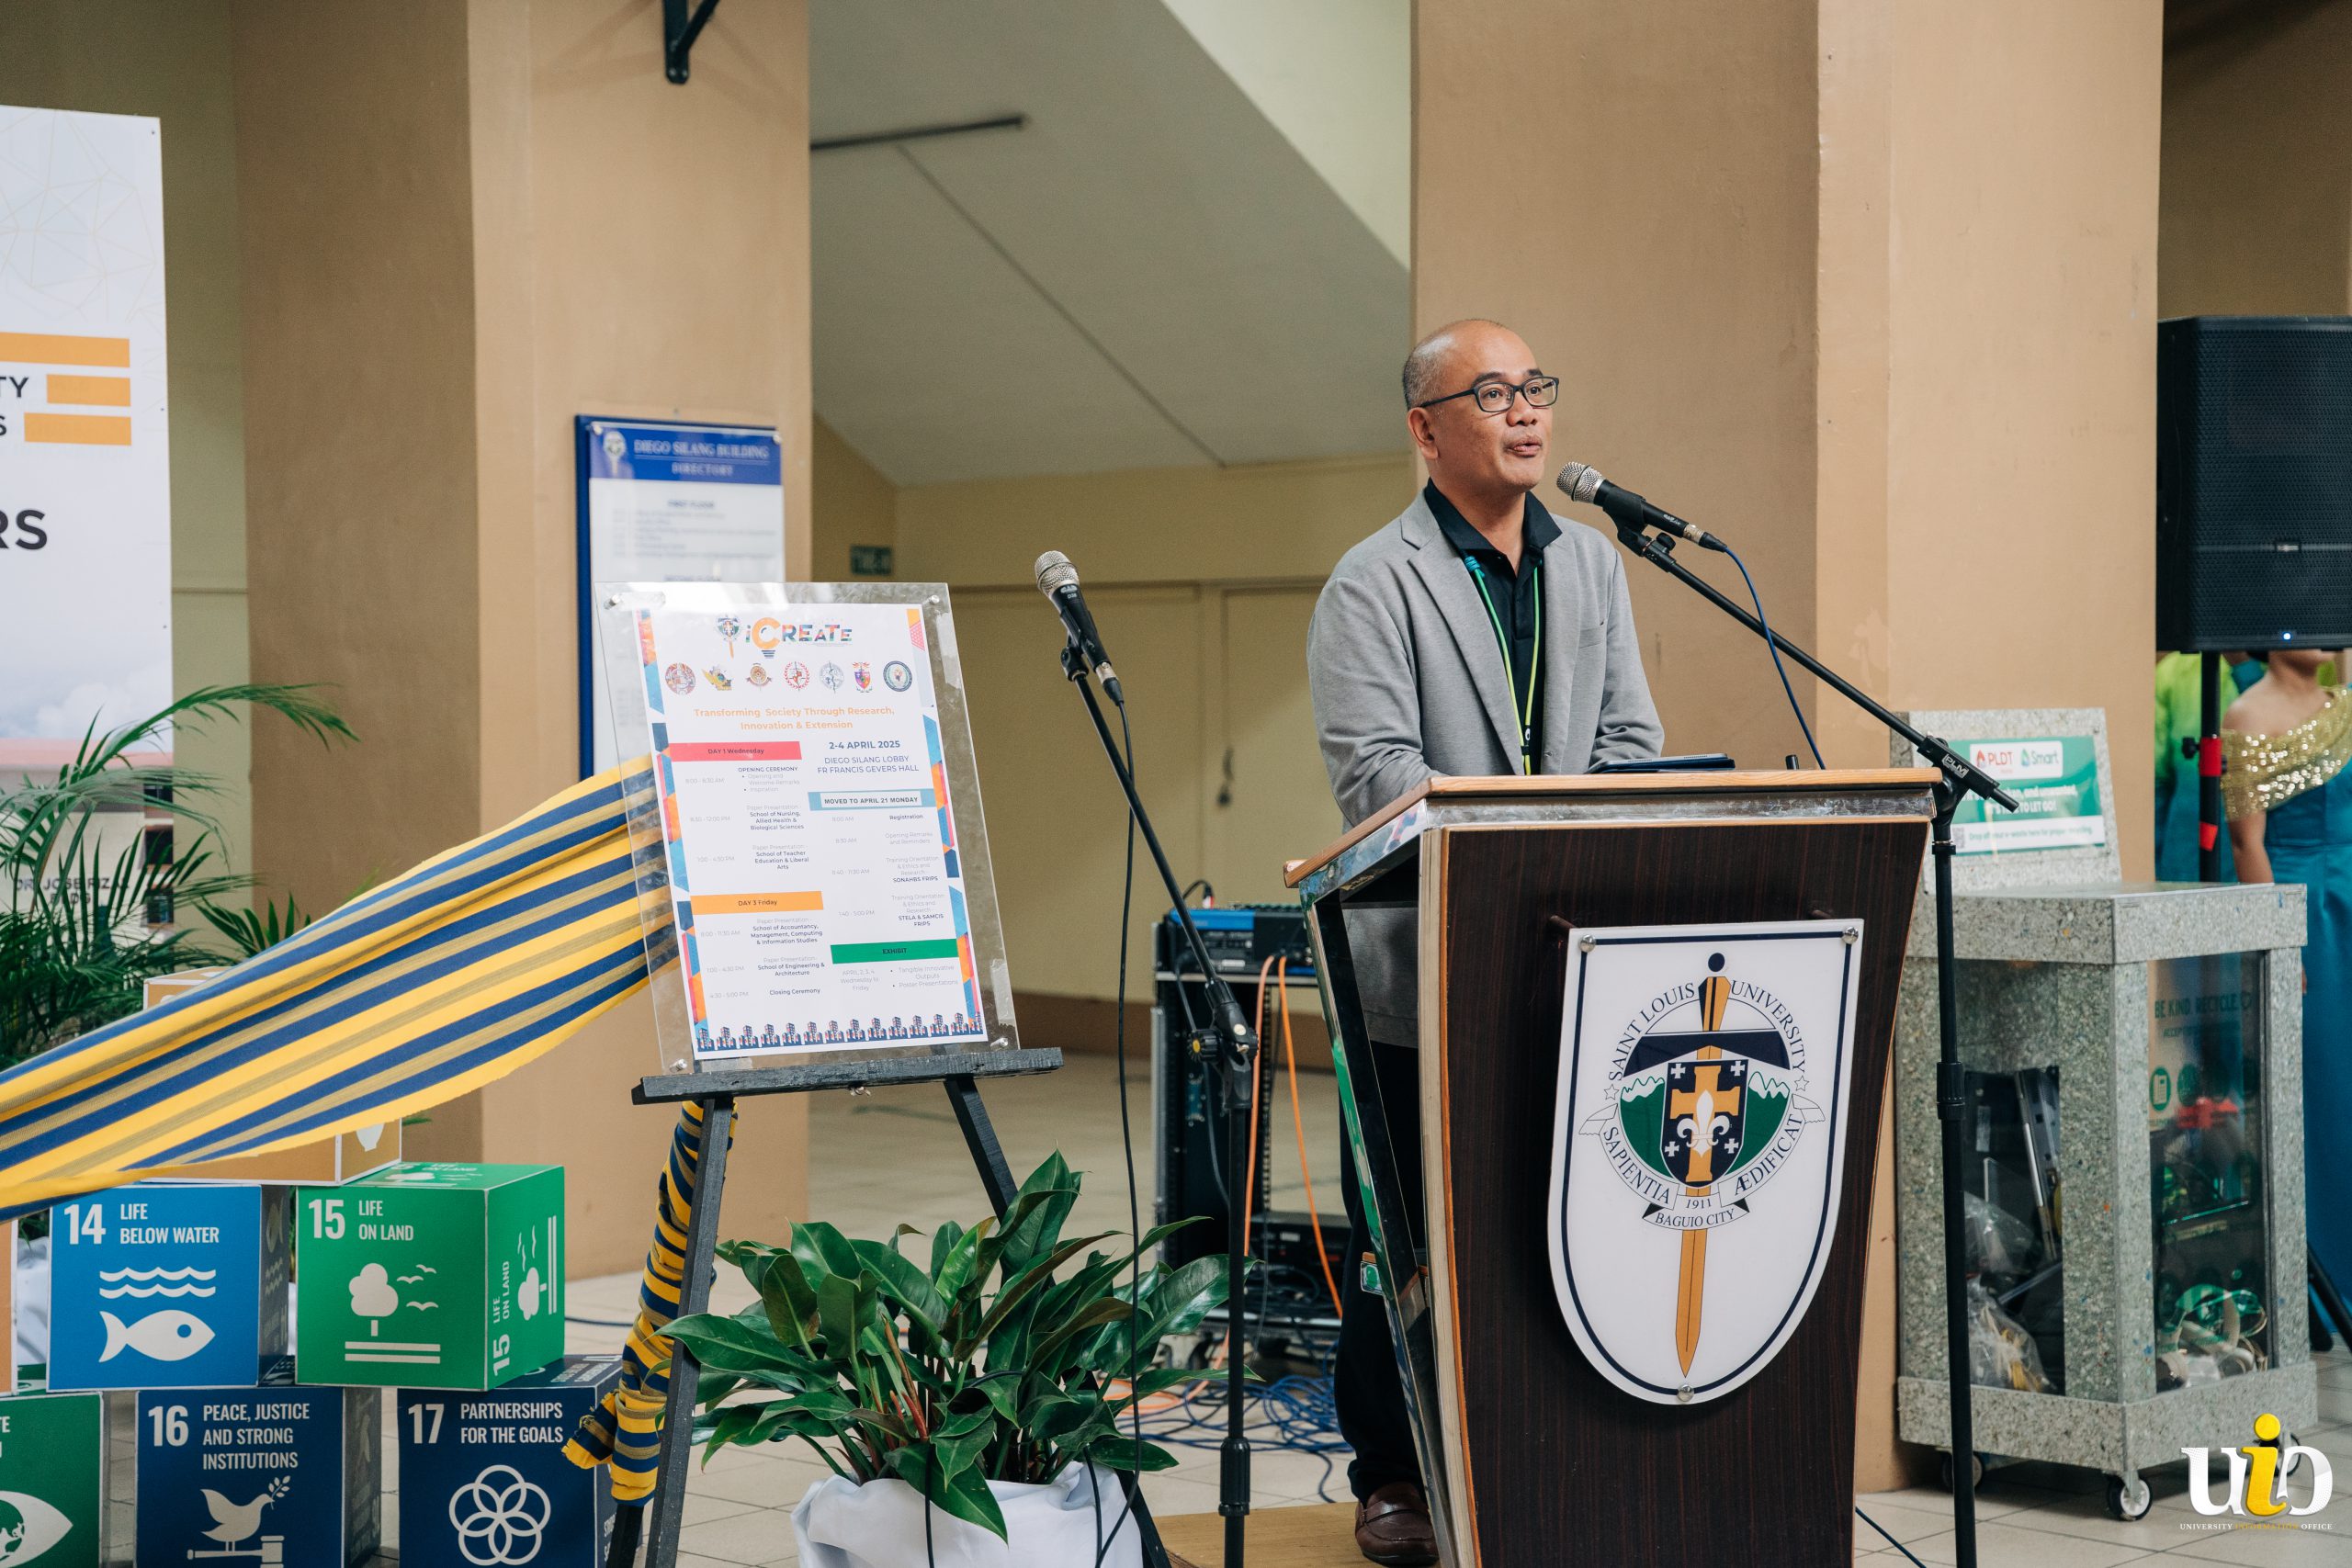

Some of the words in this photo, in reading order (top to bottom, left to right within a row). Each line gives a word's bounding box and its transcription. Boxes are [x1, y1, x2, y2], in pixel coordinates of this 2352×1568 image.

[634, 440, 670, 455] DIEGO
[673, 441, 715, 457] SILANG
[717, 444, 770, 458] BUILDING
[694, 709, 761, 718] Transforming
[766, 708, 801, 717] Society
[805, 707, 845, 717] Through
[848, 706, 894, 716] Research,
[741, 721, 793, 730] Innovation
[806, 720, 853, 728] Extension
[1988, 752, 2014, 765] PLDT
[2031, 750, 2059, 765] Smart
[1608, 1020, 1639, 1081] SAINT
[1639, 982, 1695, 1023] LOUIS
[1731, 979, 1806, 1073] UNIVERSITY
[1603, 1126, 1670, 1204] SAPIENTIA
[1734, 1113, 1803, 1195] ÆDIFICAT
[120, 1203, 148, 1220] LIFE
[359, 1200, 383, 1216] LIFE
[1685, 1199, 1712, 1209] 1911
[64, 1204, 106, 1245] 14
[309, 1199, 345, 1239] 15
[1655, 1212, 1704, 1227] BAGUIO
[1706, 1208, 1735, 1225] CITY
[120, 1228, 168, 1244] BELOW
[173, 1227, 219, 1244] WATER
[359, 1224, 377, 1240] ON
[381, 1224, 414, 1241] LAND
[503, 1300, 510, 1319] ON
[493, 1334, 510, 1376] 15
[203, 1404, 251, 1422] PEACE,
[254, 1403, 310, 1420] JUSTICE
[461, 1402, 563, 1419] PARTNERSHIPS
[148, 1405, 189, 1447] 16
[408, 1404, 444, 1444] 17
[203, 1429, 232, 1446] AND
[236, 1428, 293, 1444] STRONG
[461, 1427, 487, 1443] FOR
[490, 1427, 516, 1443] THE
[519, 1426, 563, 1443] GOALS
[203, 1452, 298, 1470] INSTITUTIONS
